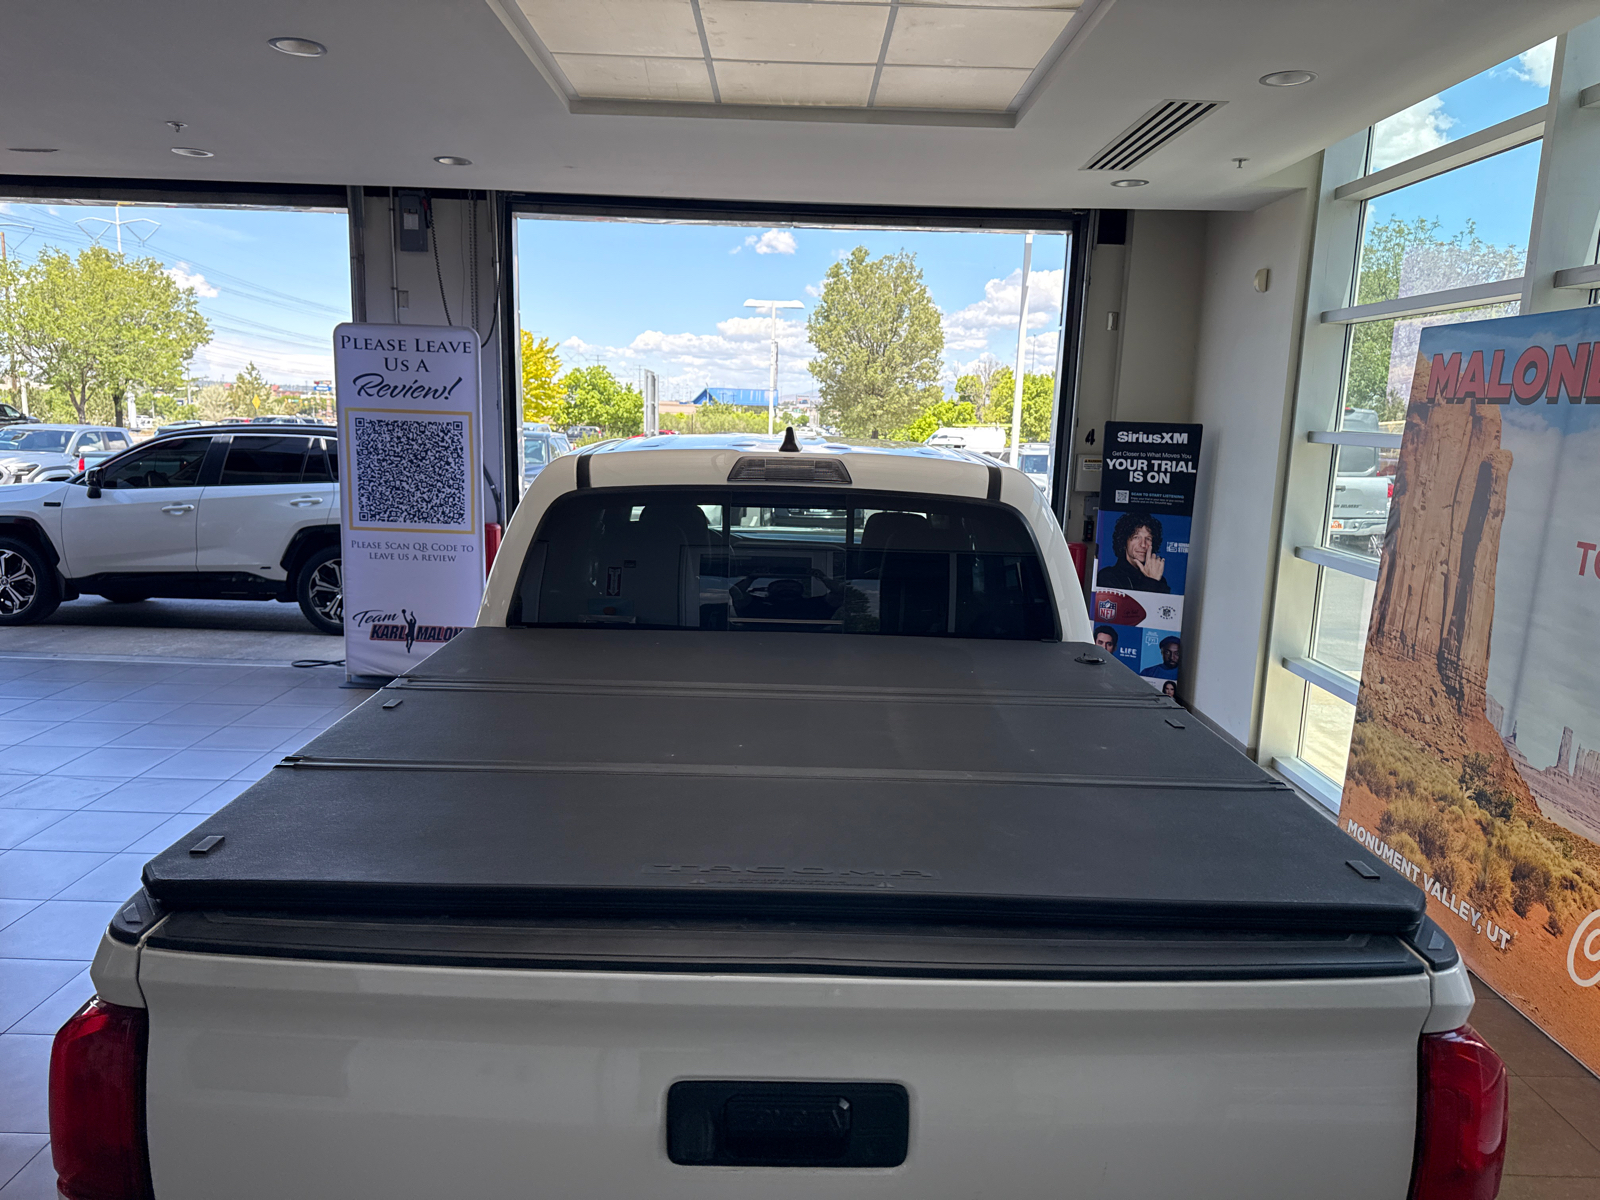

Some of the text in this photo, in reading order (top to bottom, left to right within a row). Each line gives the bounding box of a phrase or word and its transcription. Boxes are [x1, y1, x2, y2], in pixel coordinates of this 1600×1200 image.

[340, 335, 472, 354] PLEASE LEAVE
[384, 357, 430, 373] US A
[352, 373, 463, 400] Review!
[1085, 428, 1096, 446] 4
[1117, 431, 1188, 444] SiriusXM
[1106, 459, 1148, 471] YOUR
[1151, 460, 1197, 474] TRIAL
[1129, 471, 1171, 484] IS ON
[351, 540, 475, 553] PLEASE SCAN QR CODE TO
[369, 552, 395, 561] LEAVE
[398, 553, 410, 561] US
[421, 554, 457, 562] REVIEW
[352, 609, 400, 627] Team
[1099, 608, 1116, 619] NFL
[370, 624, 465, 642] KARL MALON
[1119, 647, 1137, 656] LIFE
[1347, 819, 1511, 950] MONUMENT VALLEY, UT
